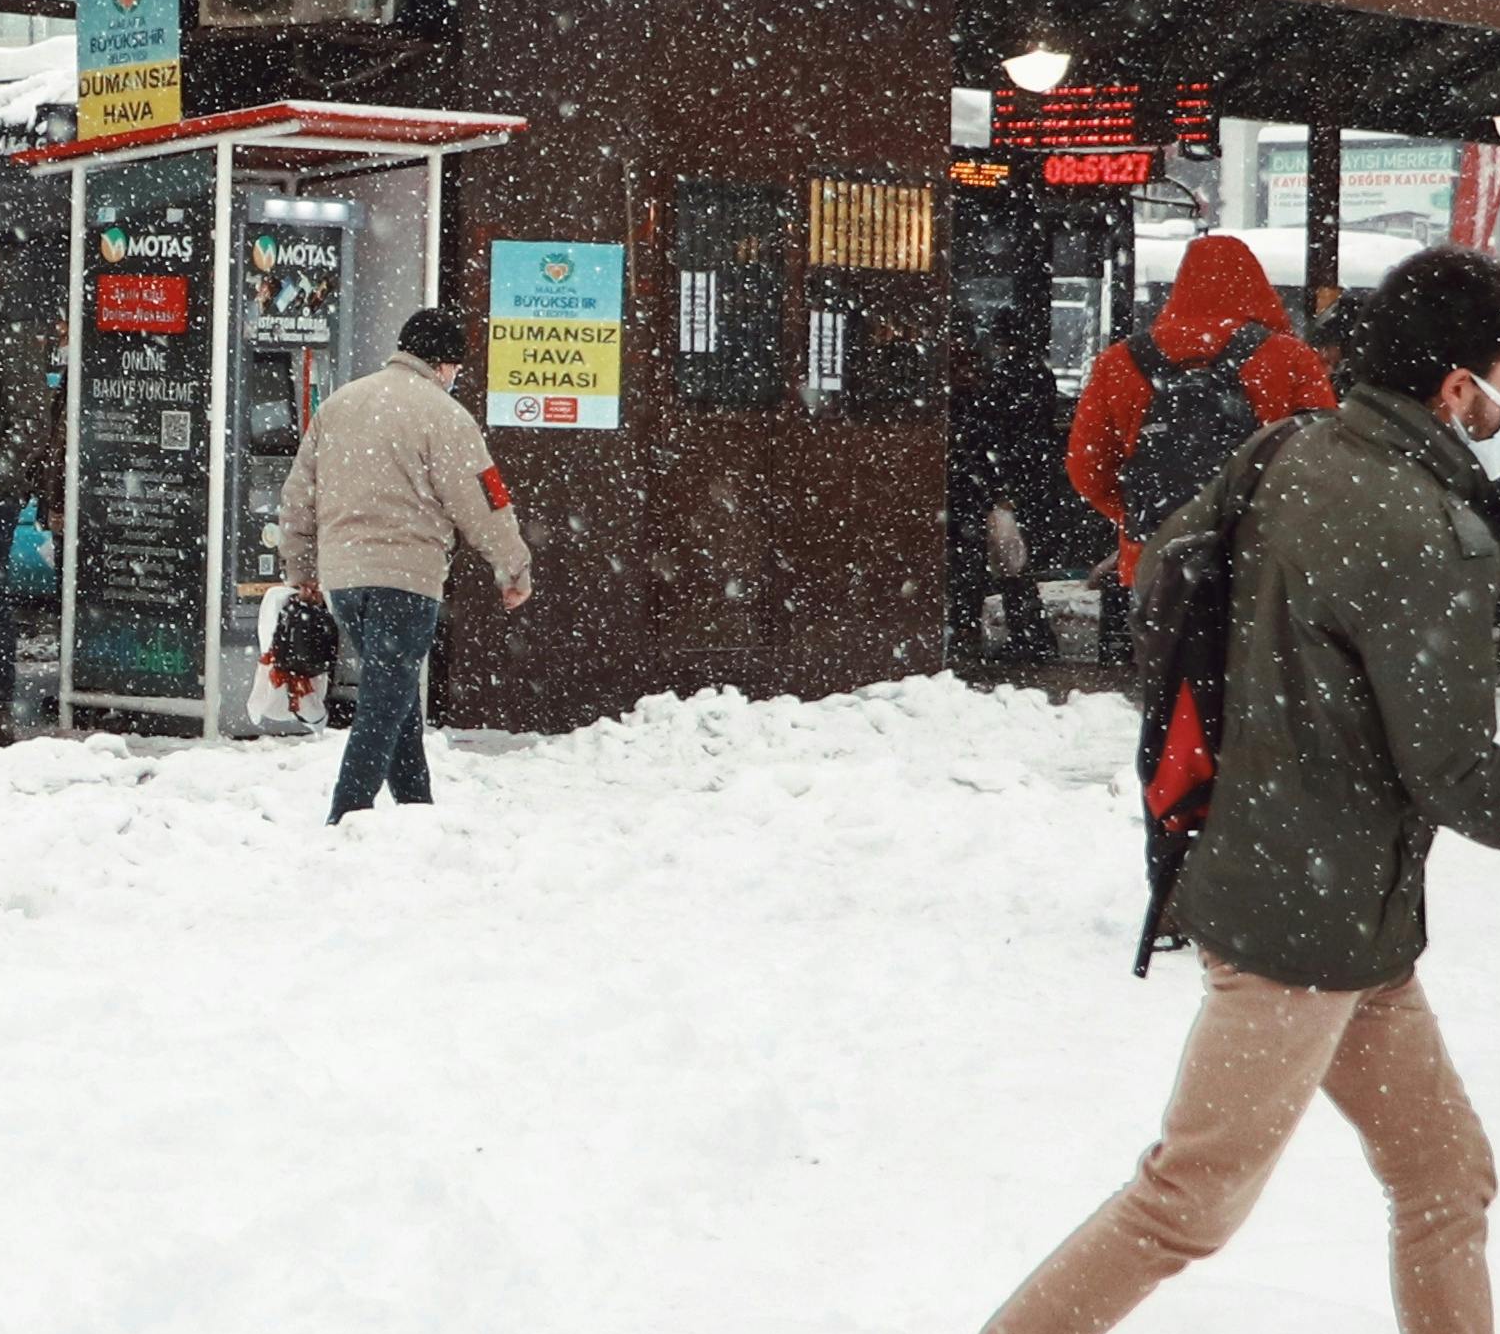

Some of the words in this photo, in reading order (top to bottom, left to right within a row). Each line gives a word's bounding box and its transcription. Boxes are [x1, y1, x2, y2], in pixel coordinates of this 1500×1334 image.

[103, 101, 154, 125] HAVA
[1394, 173, 1450, 185] KATACA
[127, 235, 193, 263] MOTAŞ
[492, 324, 617, 344] DUMANSIZ
[523, 348, 585, 365] HAVA
[508, 370, 597, 388] SAHASI
